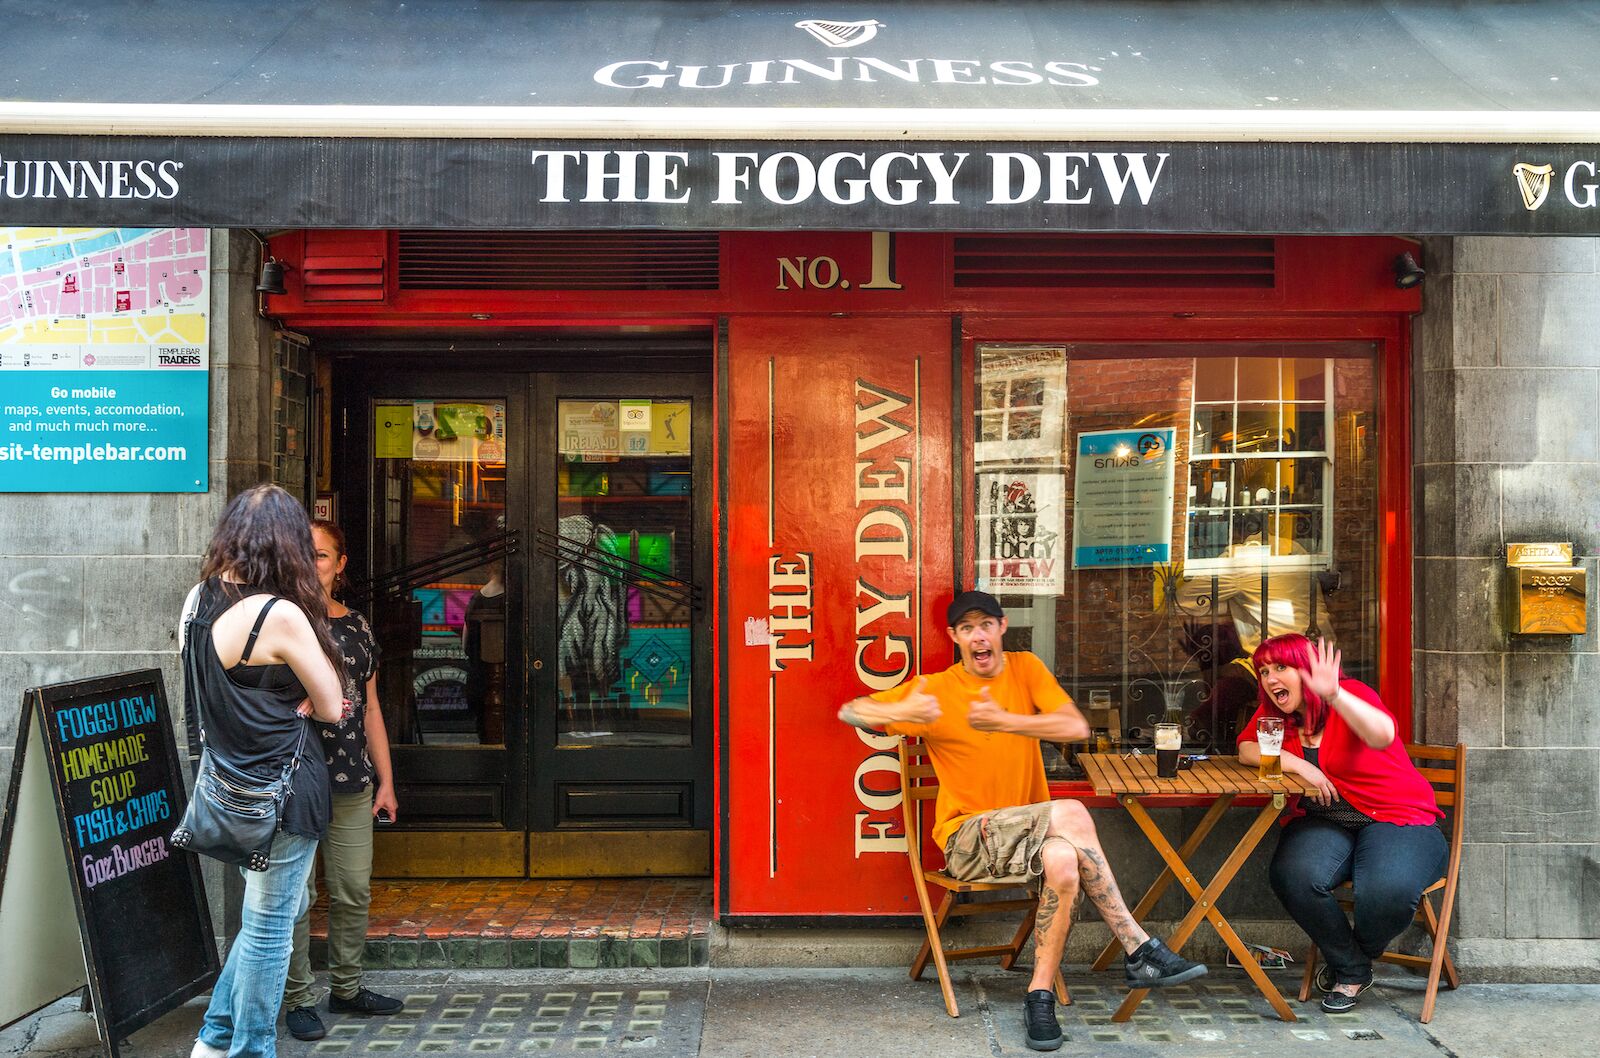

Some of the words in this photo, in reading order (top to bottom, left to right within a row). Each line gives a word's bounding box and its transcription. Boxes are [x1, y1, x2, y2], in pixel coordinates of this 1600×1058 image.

[593, 57, 1100, 89] GUINNESS
[0, 155, 180, 200] UINNESS
[532, 150, 691, 203] THE
[711, 151, 970, 205] FOGGY
[985, 152, 1170, 206] DEW
[1564, 160, 1600, 209] G
[776, 255, 850, 290] NO.
[859, 231, 903, 290] 1
[158, 355, 201, 365] TRADERS
[4, 405, 42, 418] maps,
[46, 403, 91, 417] events,
[94, 402, 185, 417] accomodation,
[51, 386, 69, 399] Go
[72, 386, 117, 399] mobile
[8, 420, 32, 432] and
[35, 420, 71, 432] much
[74, 420, 109, 432] much
[113, 423, 157, 432] more...
[854, 378, 914, 564] DEW
[989, 559, 1055, 578] DEW
[768, 551, 815, 673] THE
[56, 702, 119, 743] FOGGY
[119, 694, 158, 729] DEW
[61, 733, 149, 783] HOMEMADE
[90, 769, 137, 810] SOUP
[111, 836, 170, 877] BURGER
